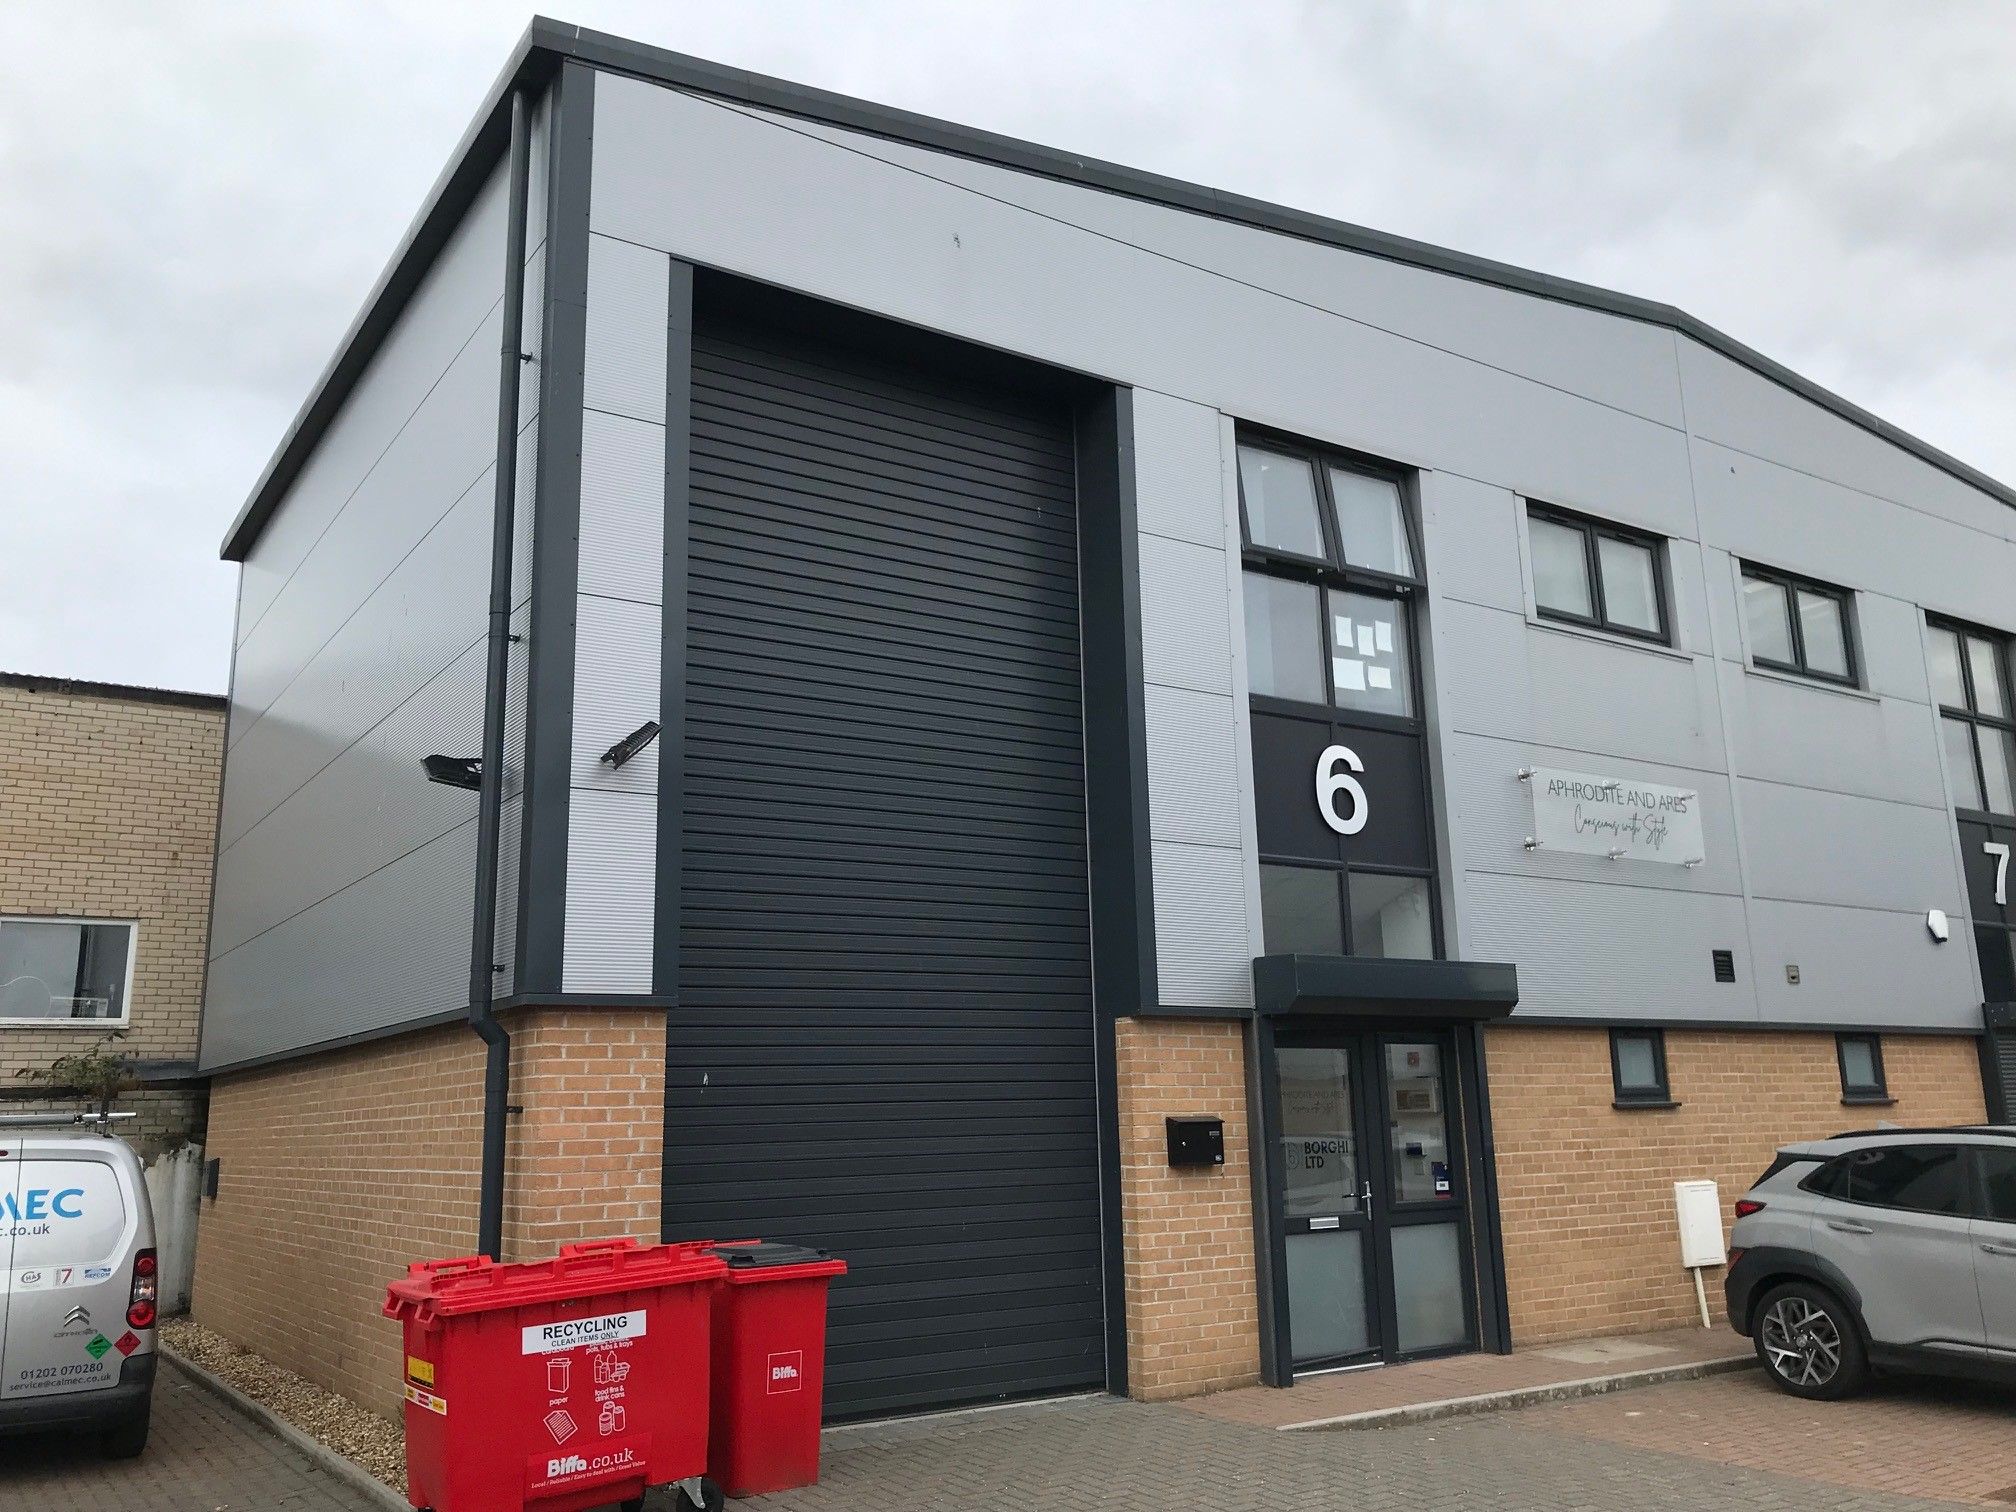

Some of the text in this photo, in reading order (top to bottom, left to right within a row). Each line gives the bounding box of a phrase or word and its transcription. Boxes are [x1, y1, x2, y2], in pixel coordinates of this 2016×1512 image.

[1316, 744, 1368, 835] 6
[1548, 779, 1688, 814] APHRODITE AND ARES
[1983, 841, 2010, 905] 7
[1304, 1140, 1349, 1154] BORGHI
[1305, 1155, 1324, 1169] LTD
[61, 1268, 73, 1284] 7
[543, 1316, 628, 1340] RECYCLING
[551, 1338, 576, 1348] CLEAN
[577, 1334, 599, 1344] ITEMS
[600, 1330, 620, 1341] ONLY
[20, 1362, 103, 1380] 01202 070280
[9, 1373, 112, 1391] service@calmec.co.uk
[549, 1396, 568, 1407] paper
[547, 1447, 634, 1478] Biffa.co.uk
